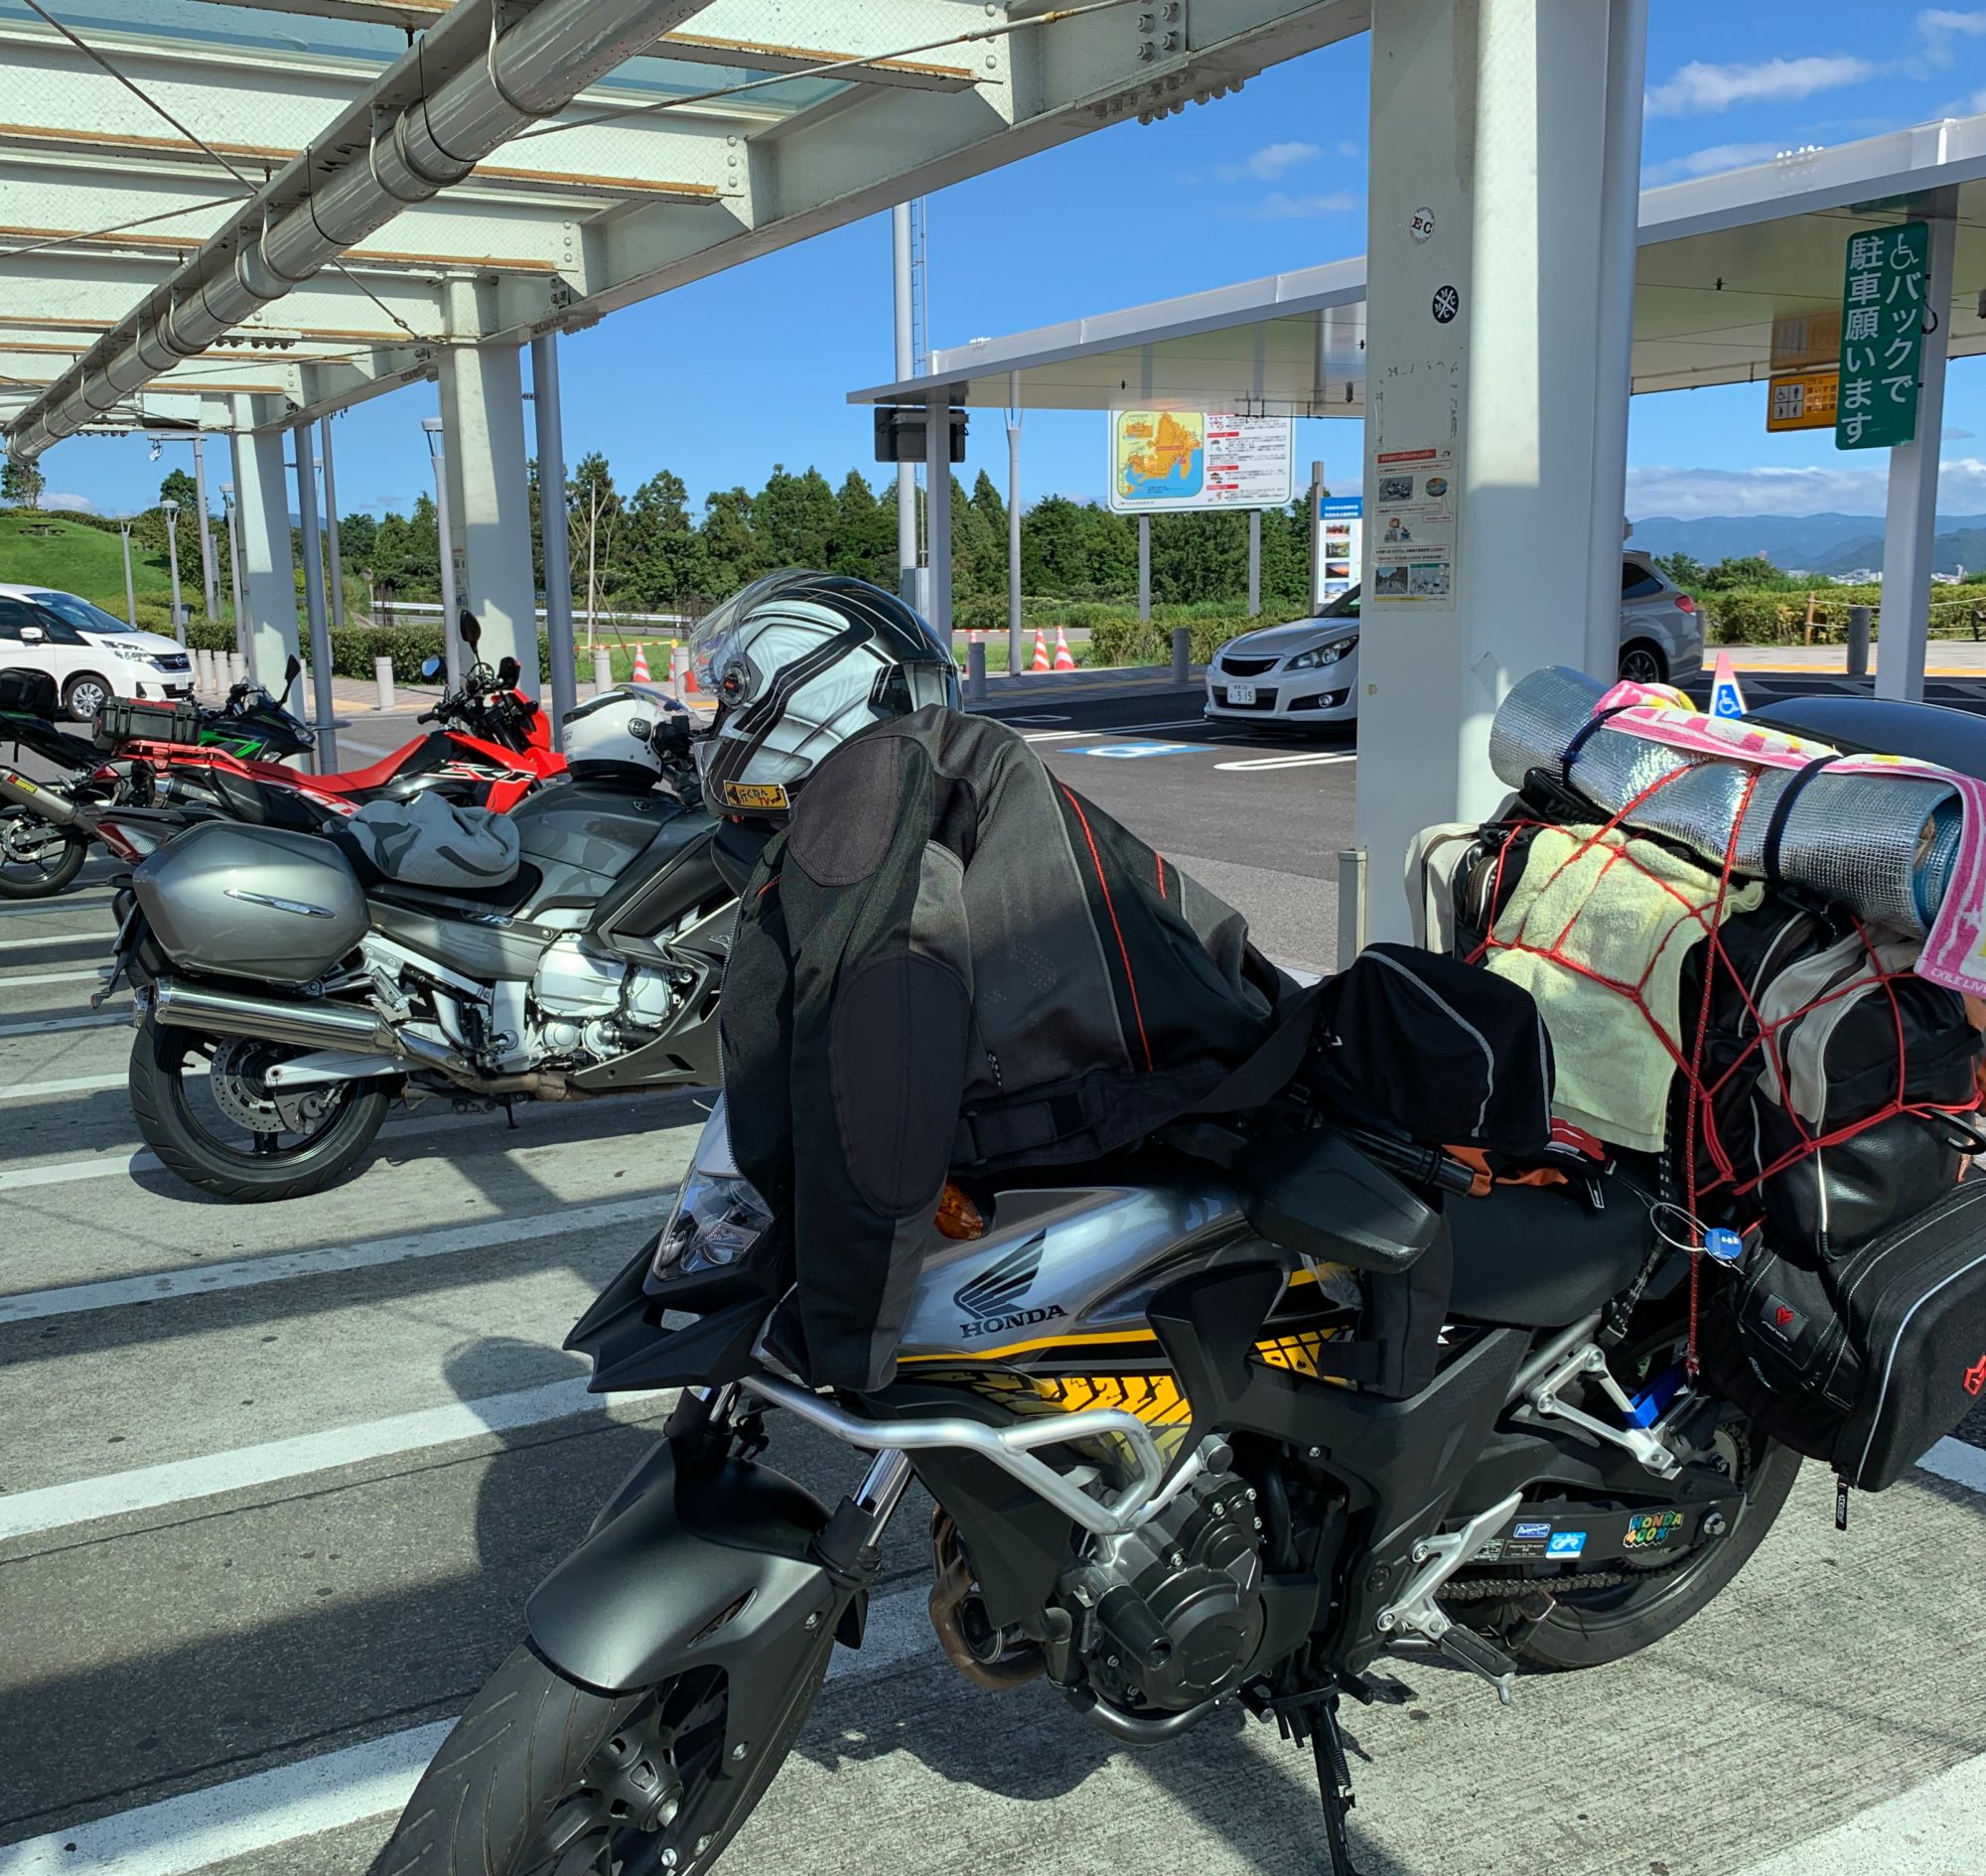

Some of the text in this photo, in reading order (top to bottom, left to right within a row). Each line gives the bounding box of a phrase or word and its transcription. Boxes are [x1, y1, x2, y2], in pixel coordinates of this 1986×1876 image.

[1841, 235, 1885, 444] 駐車願います
[1881, 271, 1921, 403] バックで
[959, 1304, 1068, 1339] HONDA
[1631, 1514, 1682, 1529] HONDA
